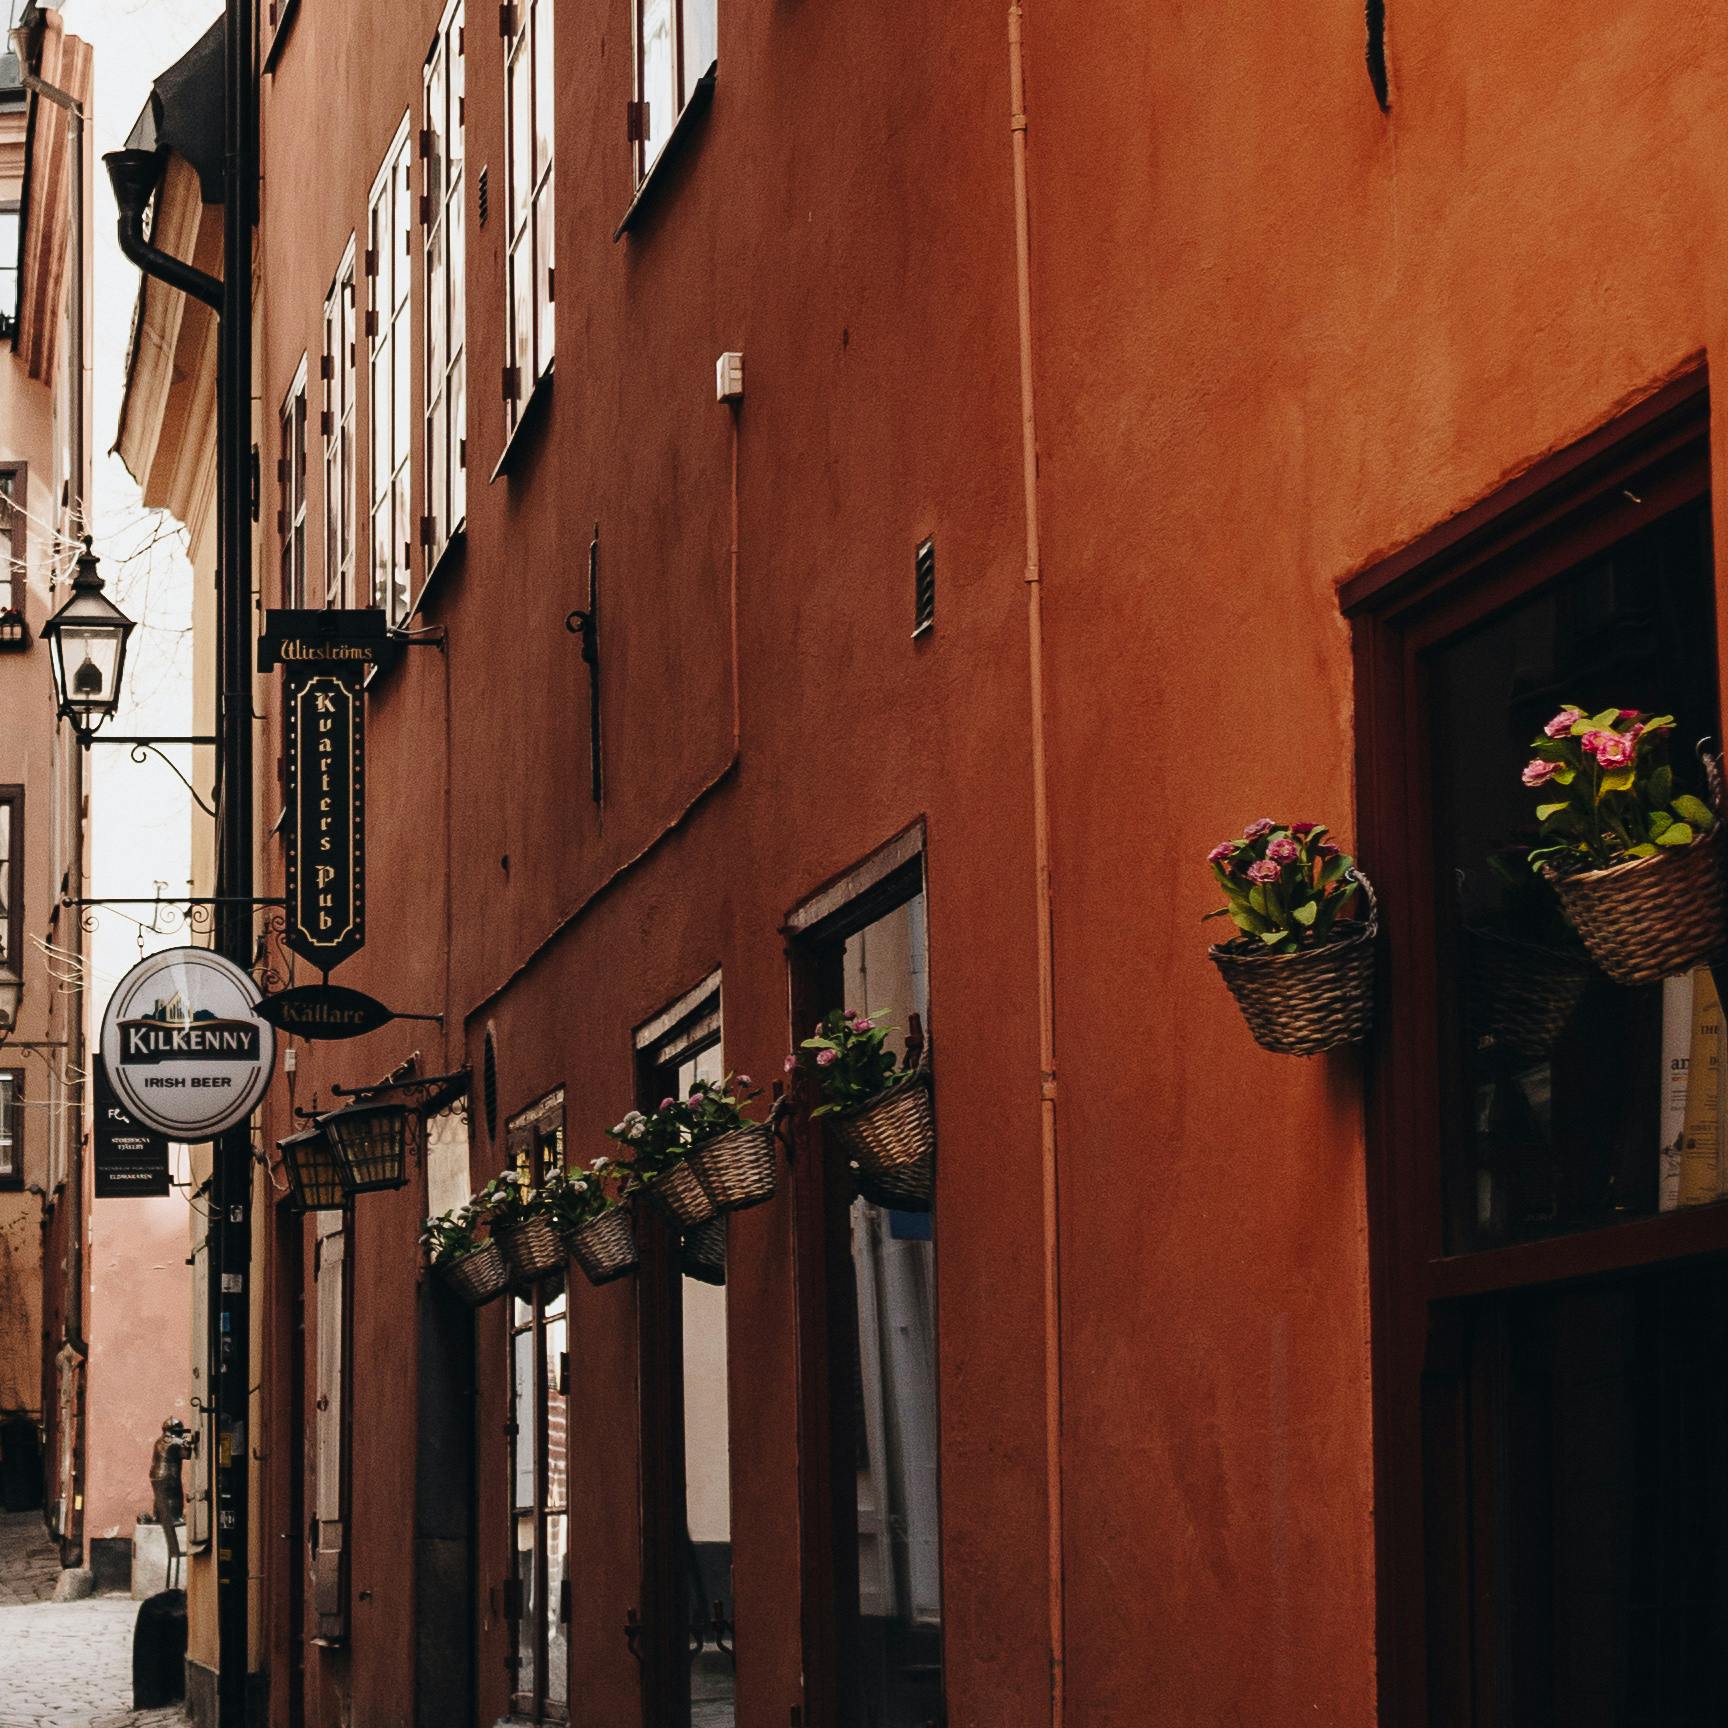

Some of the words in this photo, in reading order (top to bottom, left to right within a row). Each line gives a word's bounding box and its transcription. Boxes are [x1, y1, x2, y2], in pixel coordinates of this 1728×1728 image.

[314, 692, 336, 852] Kvarters
[314, 865, 336, 931] Pub
[129, 1026, 252, 1055] KILKENNY
[144, 1077, 186, 1088] IRISH
[190, 1077, 232, 1088] BEER
